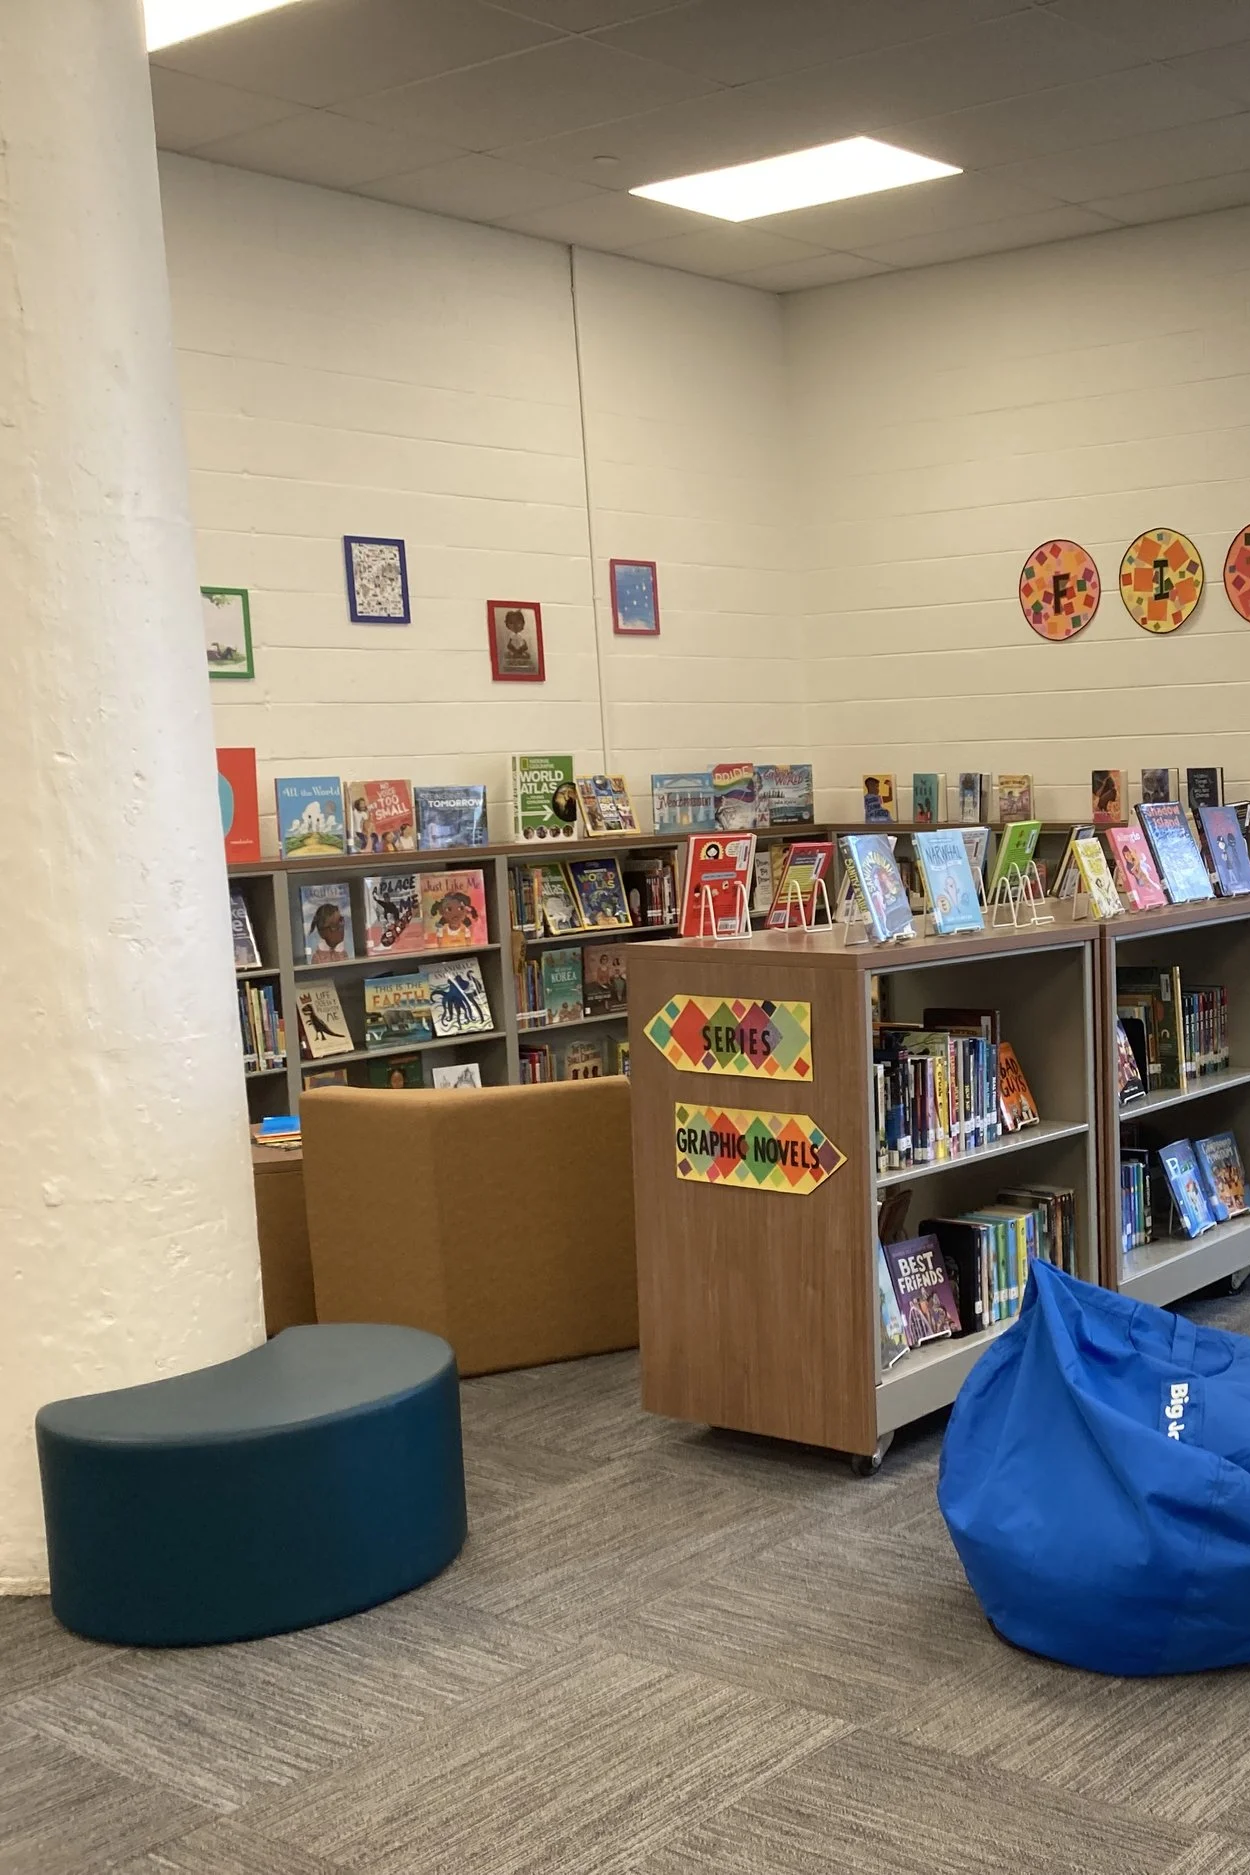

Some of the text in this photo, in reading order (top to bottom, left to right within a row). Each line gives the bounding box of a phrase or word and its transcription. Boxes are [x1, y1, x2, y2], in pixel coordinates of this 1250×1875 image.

[519, 770, 564, 782] WORLD
[714, 765, 749, 783] PRIDE
[282, 787, 298, 797] All
[312, 785, 340, 796] World
[520, 783, 558, 794] ATLAS
[377, 795, 399, 806] TOO
[428, 799, 483, 808] TOMORROW
[375, 804, 410, 820] SMALL
[380, 876, 416, 895] PLACE
[374, 985, 390, 994] THIS
[406, 982, 423, 991] THE
[372, 990, 425, 1007] EARTH
[702, 1025, 771, 1056] SERIES
[1001, 1075, 1027, 1098] GUYS
[676, 1127, 820, 1170] GRAPHIC NOVELS
[898, 1251, 934, 1277] BEST
[1165, 1383, 1189, 1419] Big
